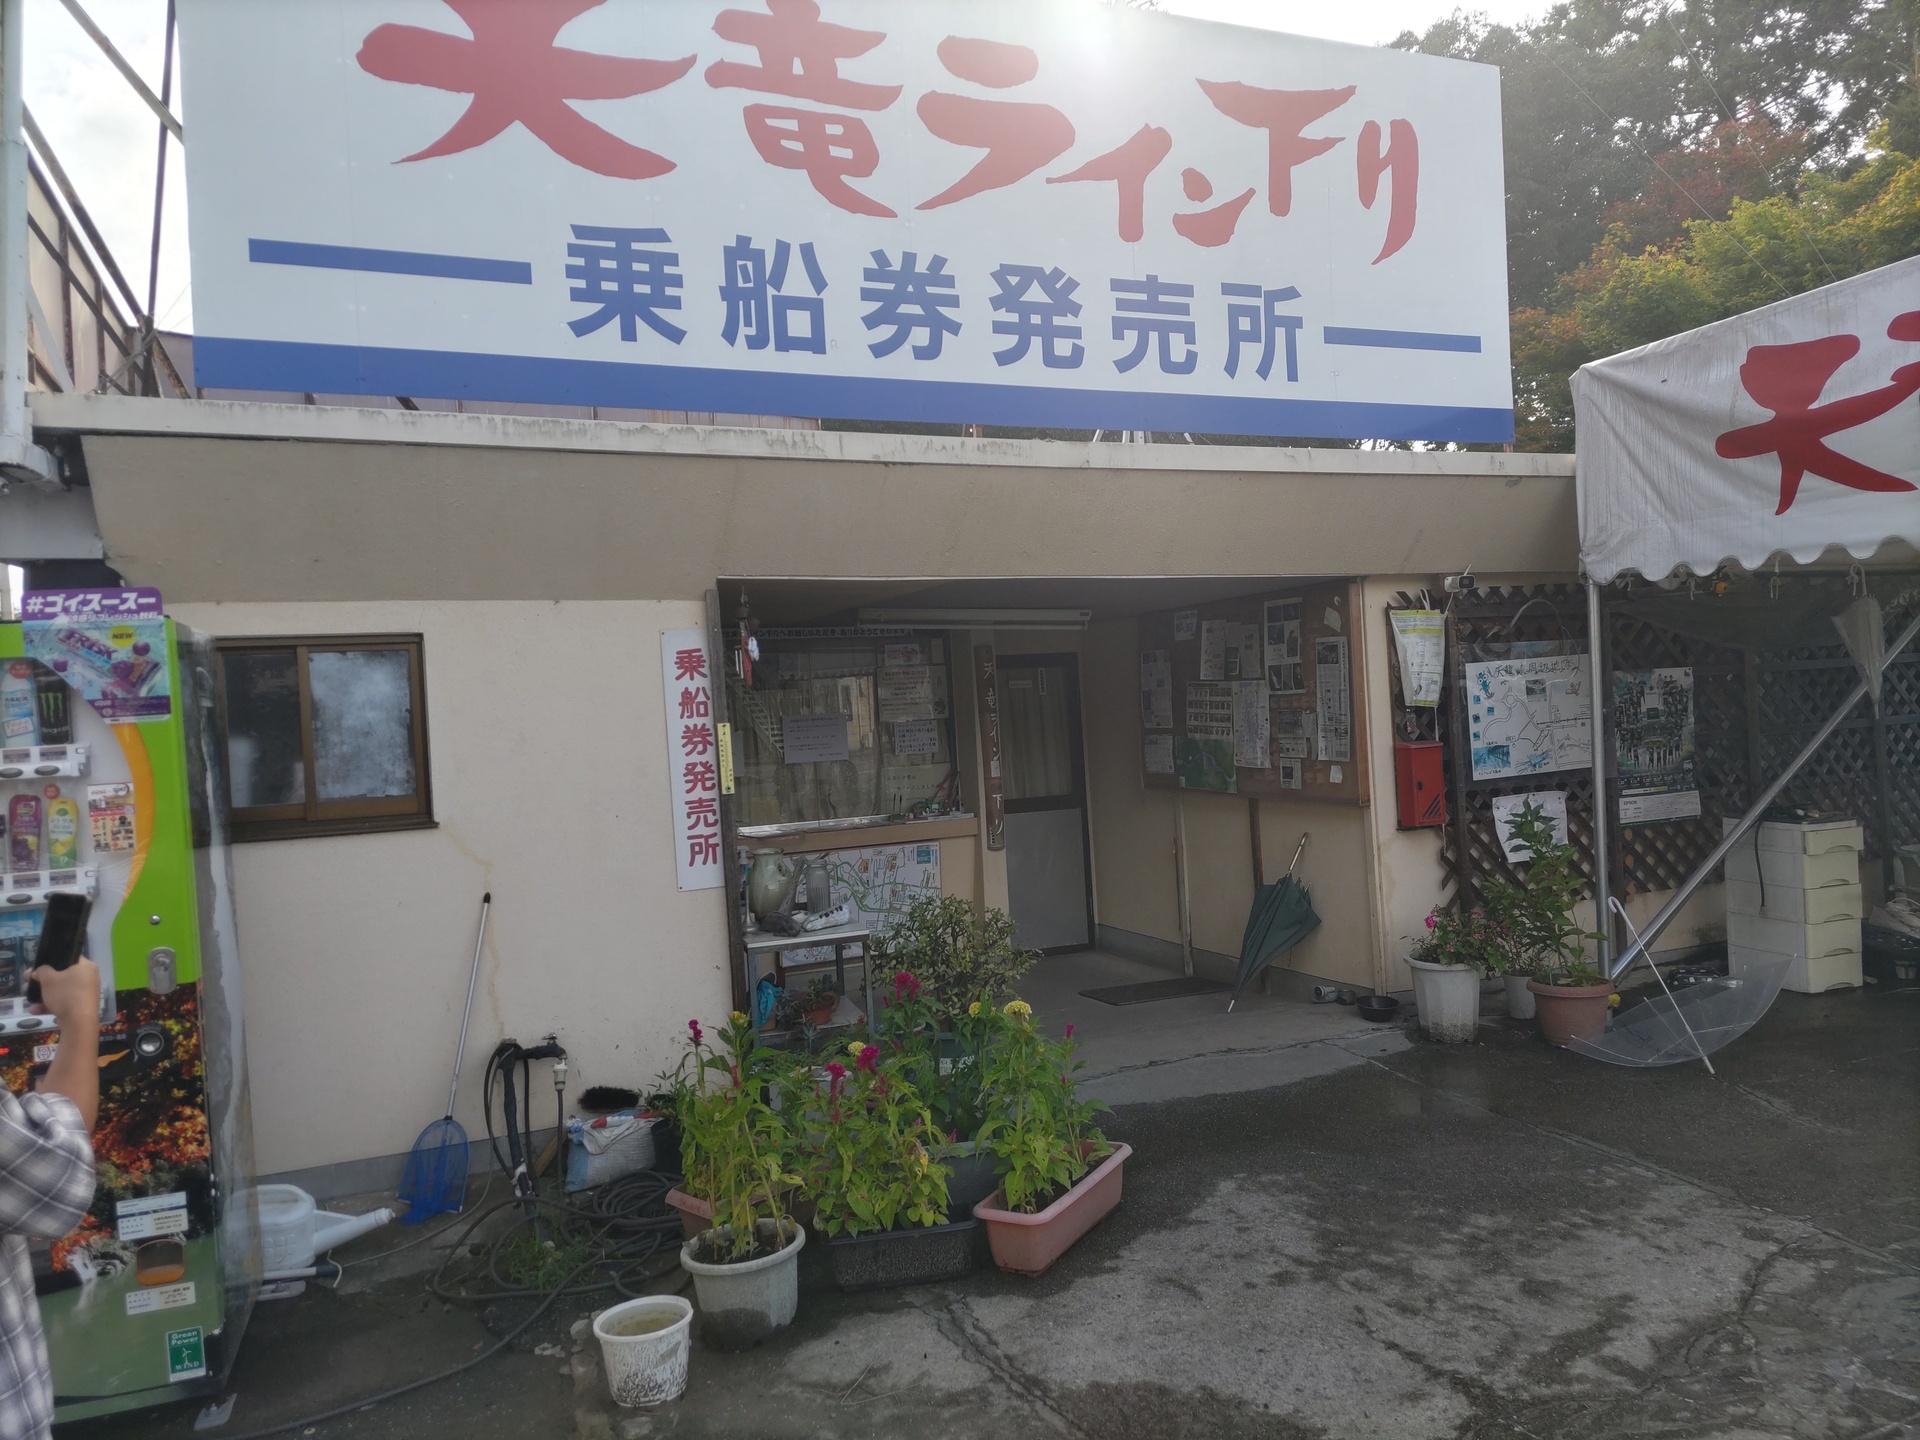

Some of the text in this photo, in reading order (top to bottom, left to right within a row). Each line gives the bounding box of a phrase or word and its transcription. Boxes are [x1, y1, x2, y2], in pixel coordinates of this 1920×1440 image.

[565, 223, 1304, 382] 乗船券発売所
[1714, 310, 1920, 516] 天
[65, 628, 118, 661] FRISK
[111, 631, 134, 640] NEW
[674, 646, 722, 868] 乗船券発売所
[171, 1330, 198, 1340] Green
[171, 1336, 199, 1346] Power
[174, 1361, 200, 1371] WIND
